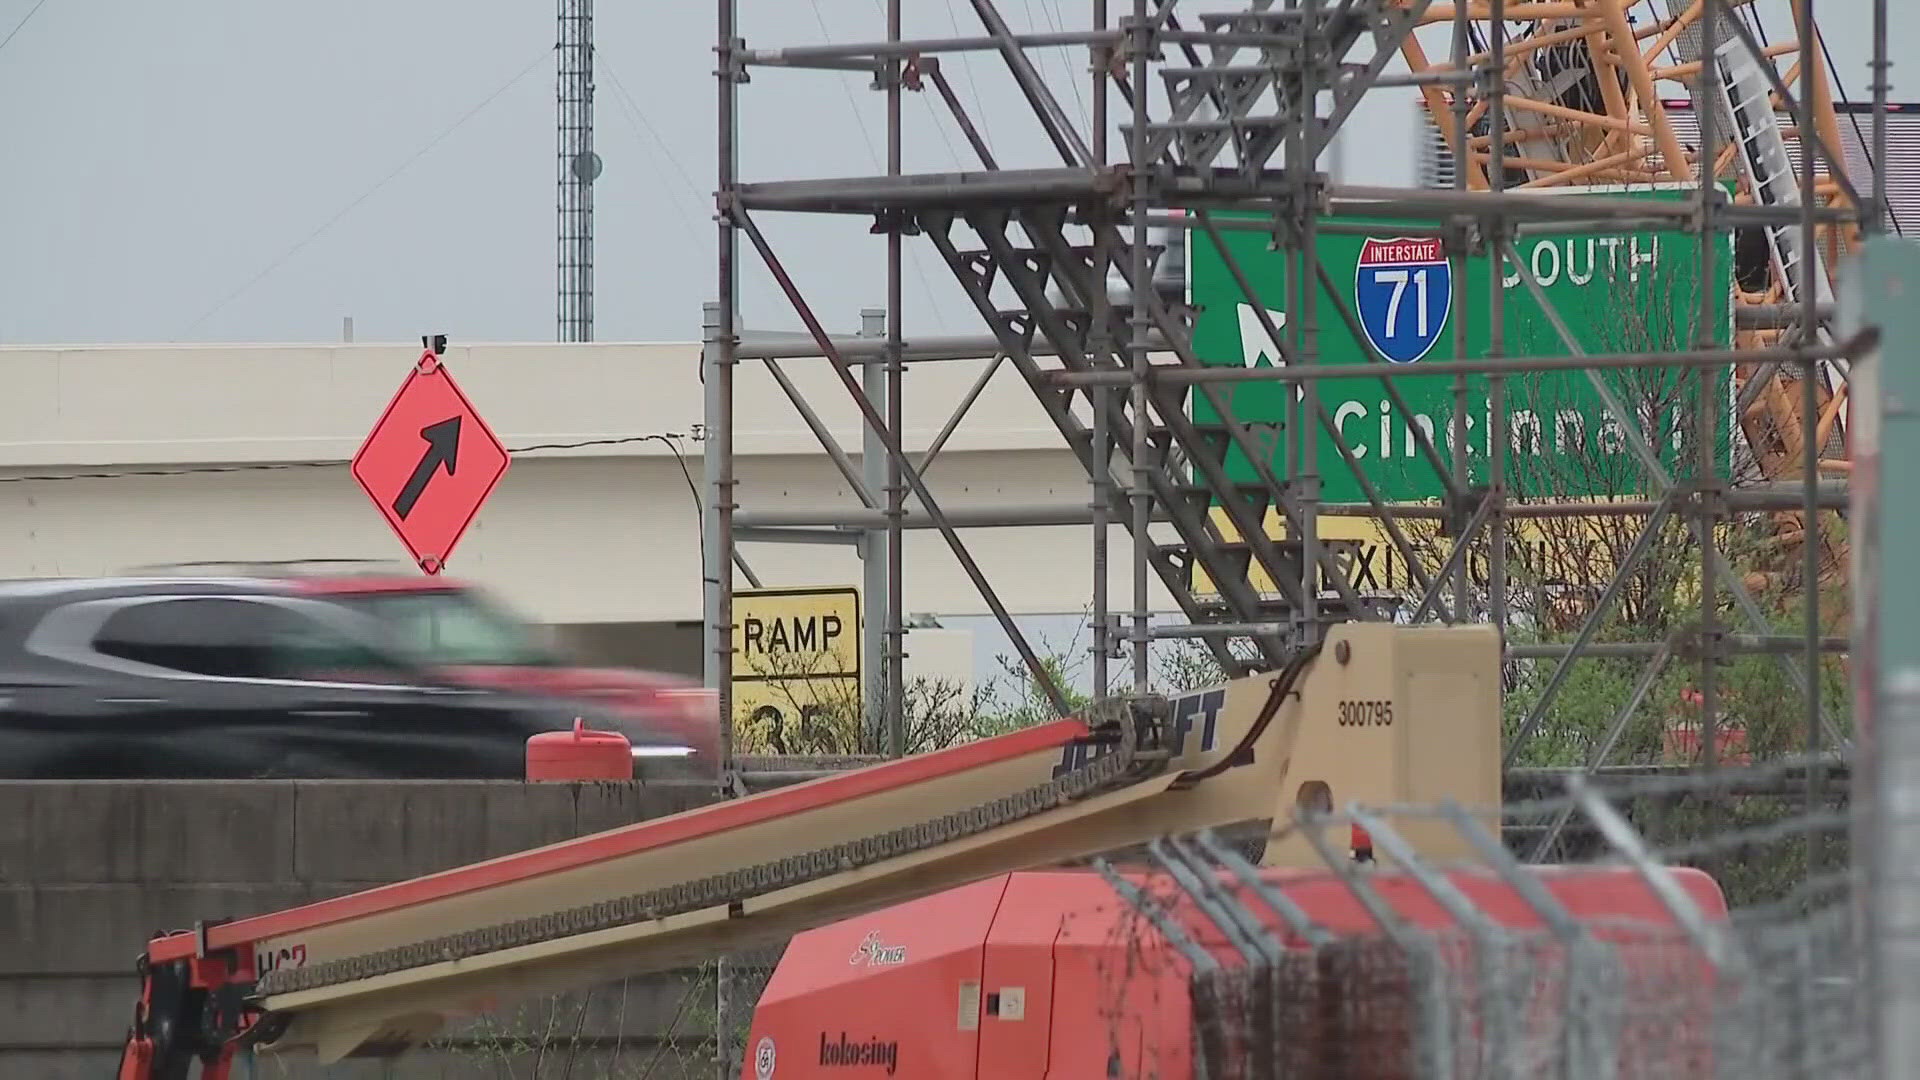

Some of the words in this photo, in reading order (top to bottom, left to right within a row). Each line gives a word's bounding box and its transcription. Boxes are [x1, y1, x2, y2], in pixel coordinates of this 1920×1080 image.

[1370, 245, 1436, 263] INTERSTATE
[1375, 270, 1428, 338] 71
[744, 615, 842, 654] RAMP
[1338, 700, 1393, 727] 300795
[819, 1031, 898, 1076] kokosing
